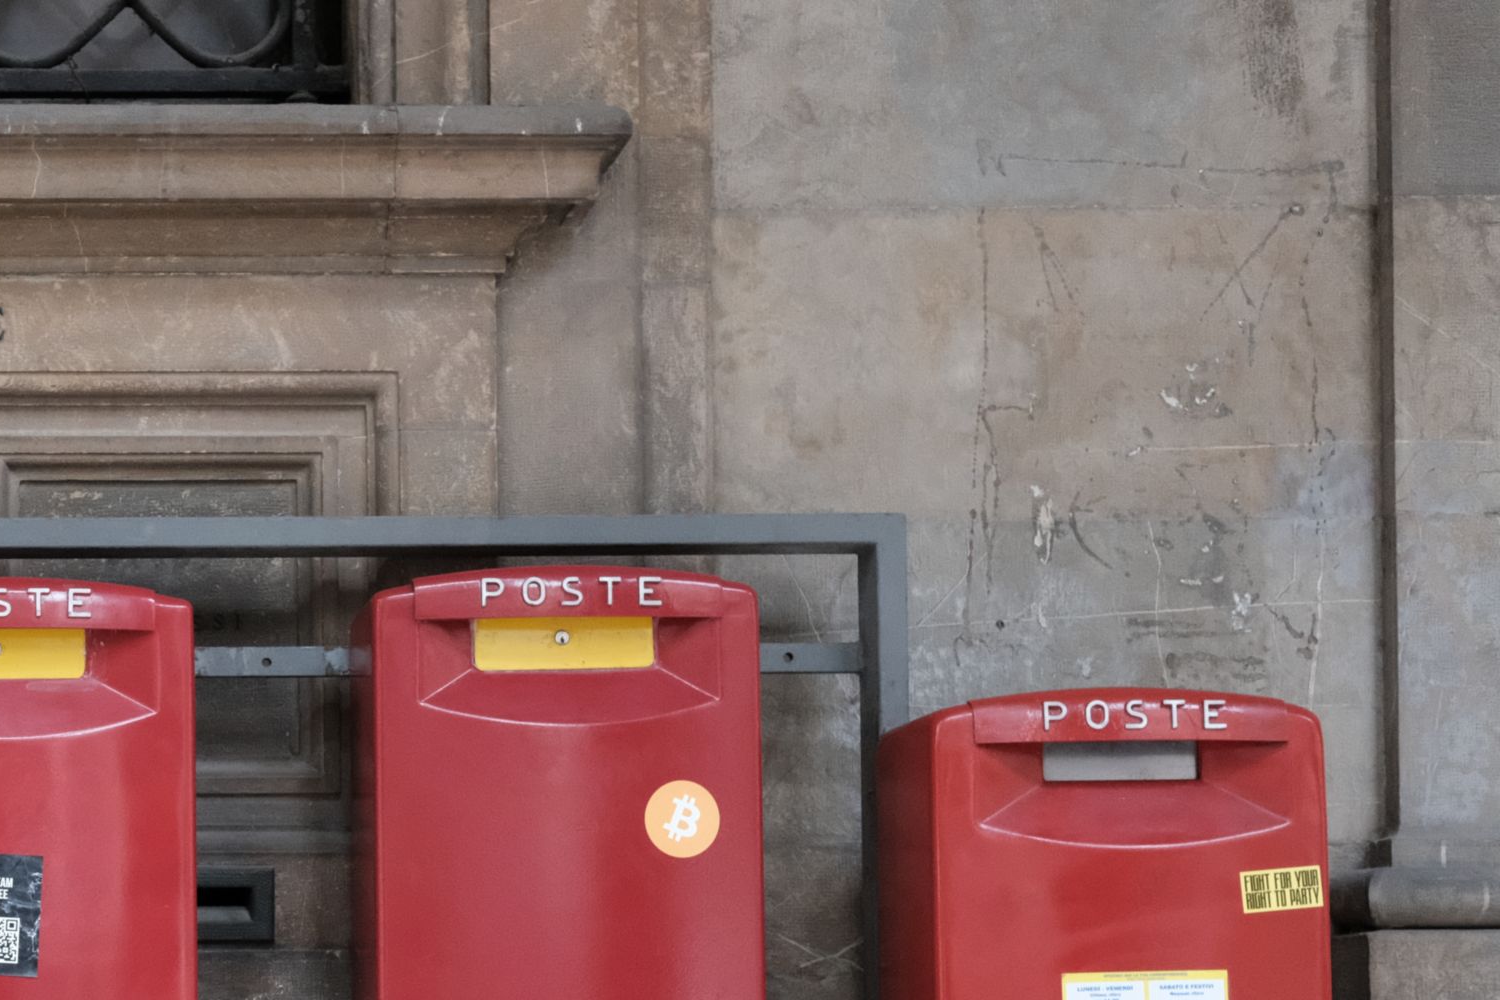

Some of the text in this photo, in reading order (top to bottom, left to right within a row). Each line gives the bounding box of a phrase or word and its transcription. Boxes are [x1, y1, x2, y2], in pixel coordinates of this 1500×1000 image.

[480, 576, 662, 607] POSTE
[1043, 700, 1228, 730] POSTE
[1243, 869, 1320, 892] FIGHT FOR YOUR
[1245, 887, 1320, 910] RIGHT TO PARTY
